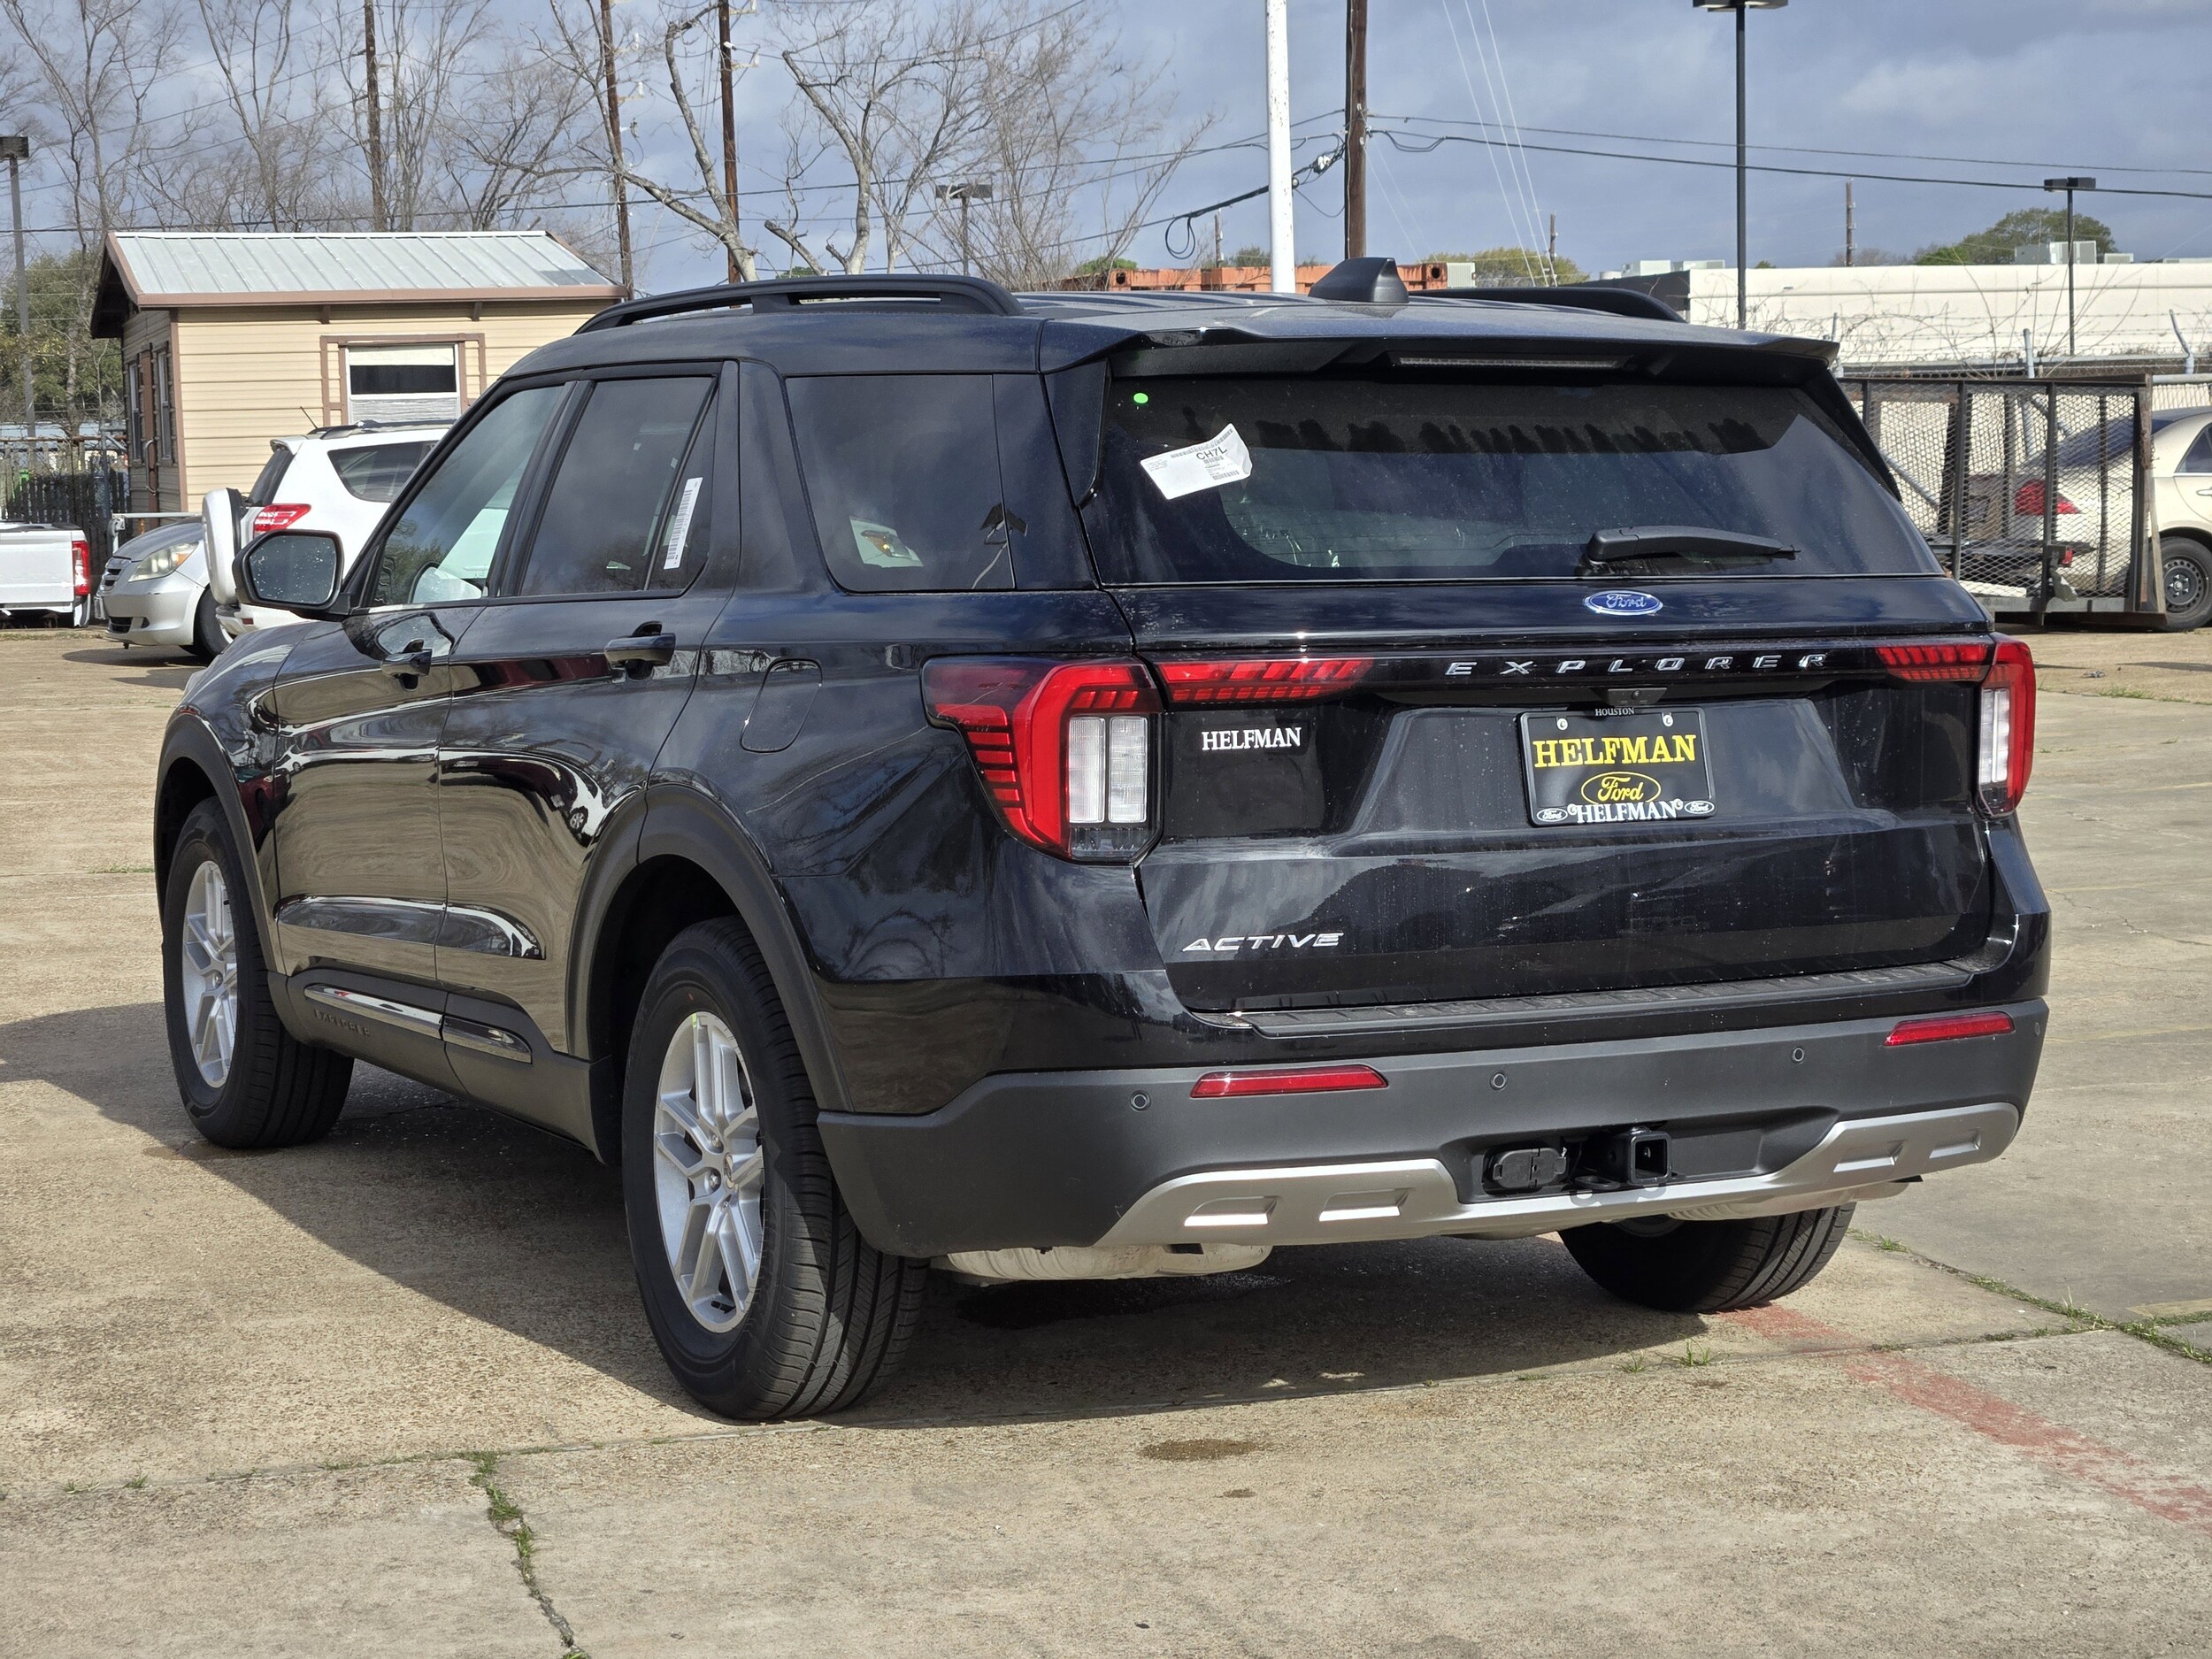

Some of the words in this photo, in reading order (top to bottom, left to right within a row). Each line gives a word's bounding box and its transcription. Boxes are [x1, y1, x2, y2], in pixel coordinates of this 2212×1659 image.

[1196, 446, 1228, 460] CH7L
[1606, 594, 1647, 608] Ford
[1445, 653, 1827, 675] EXPLORER
[1594, 707, 1635, 717] HOUSTON
[1202, 726, 1302, 750] HELFMAN
[1532, 734, 1697, 767] HELFMAN
[1597, 776, 1644, 801] Ford
[1576, 801, 1678, 824] HELFMAN
[1182, 933, 1344, 952] ACTIVE
